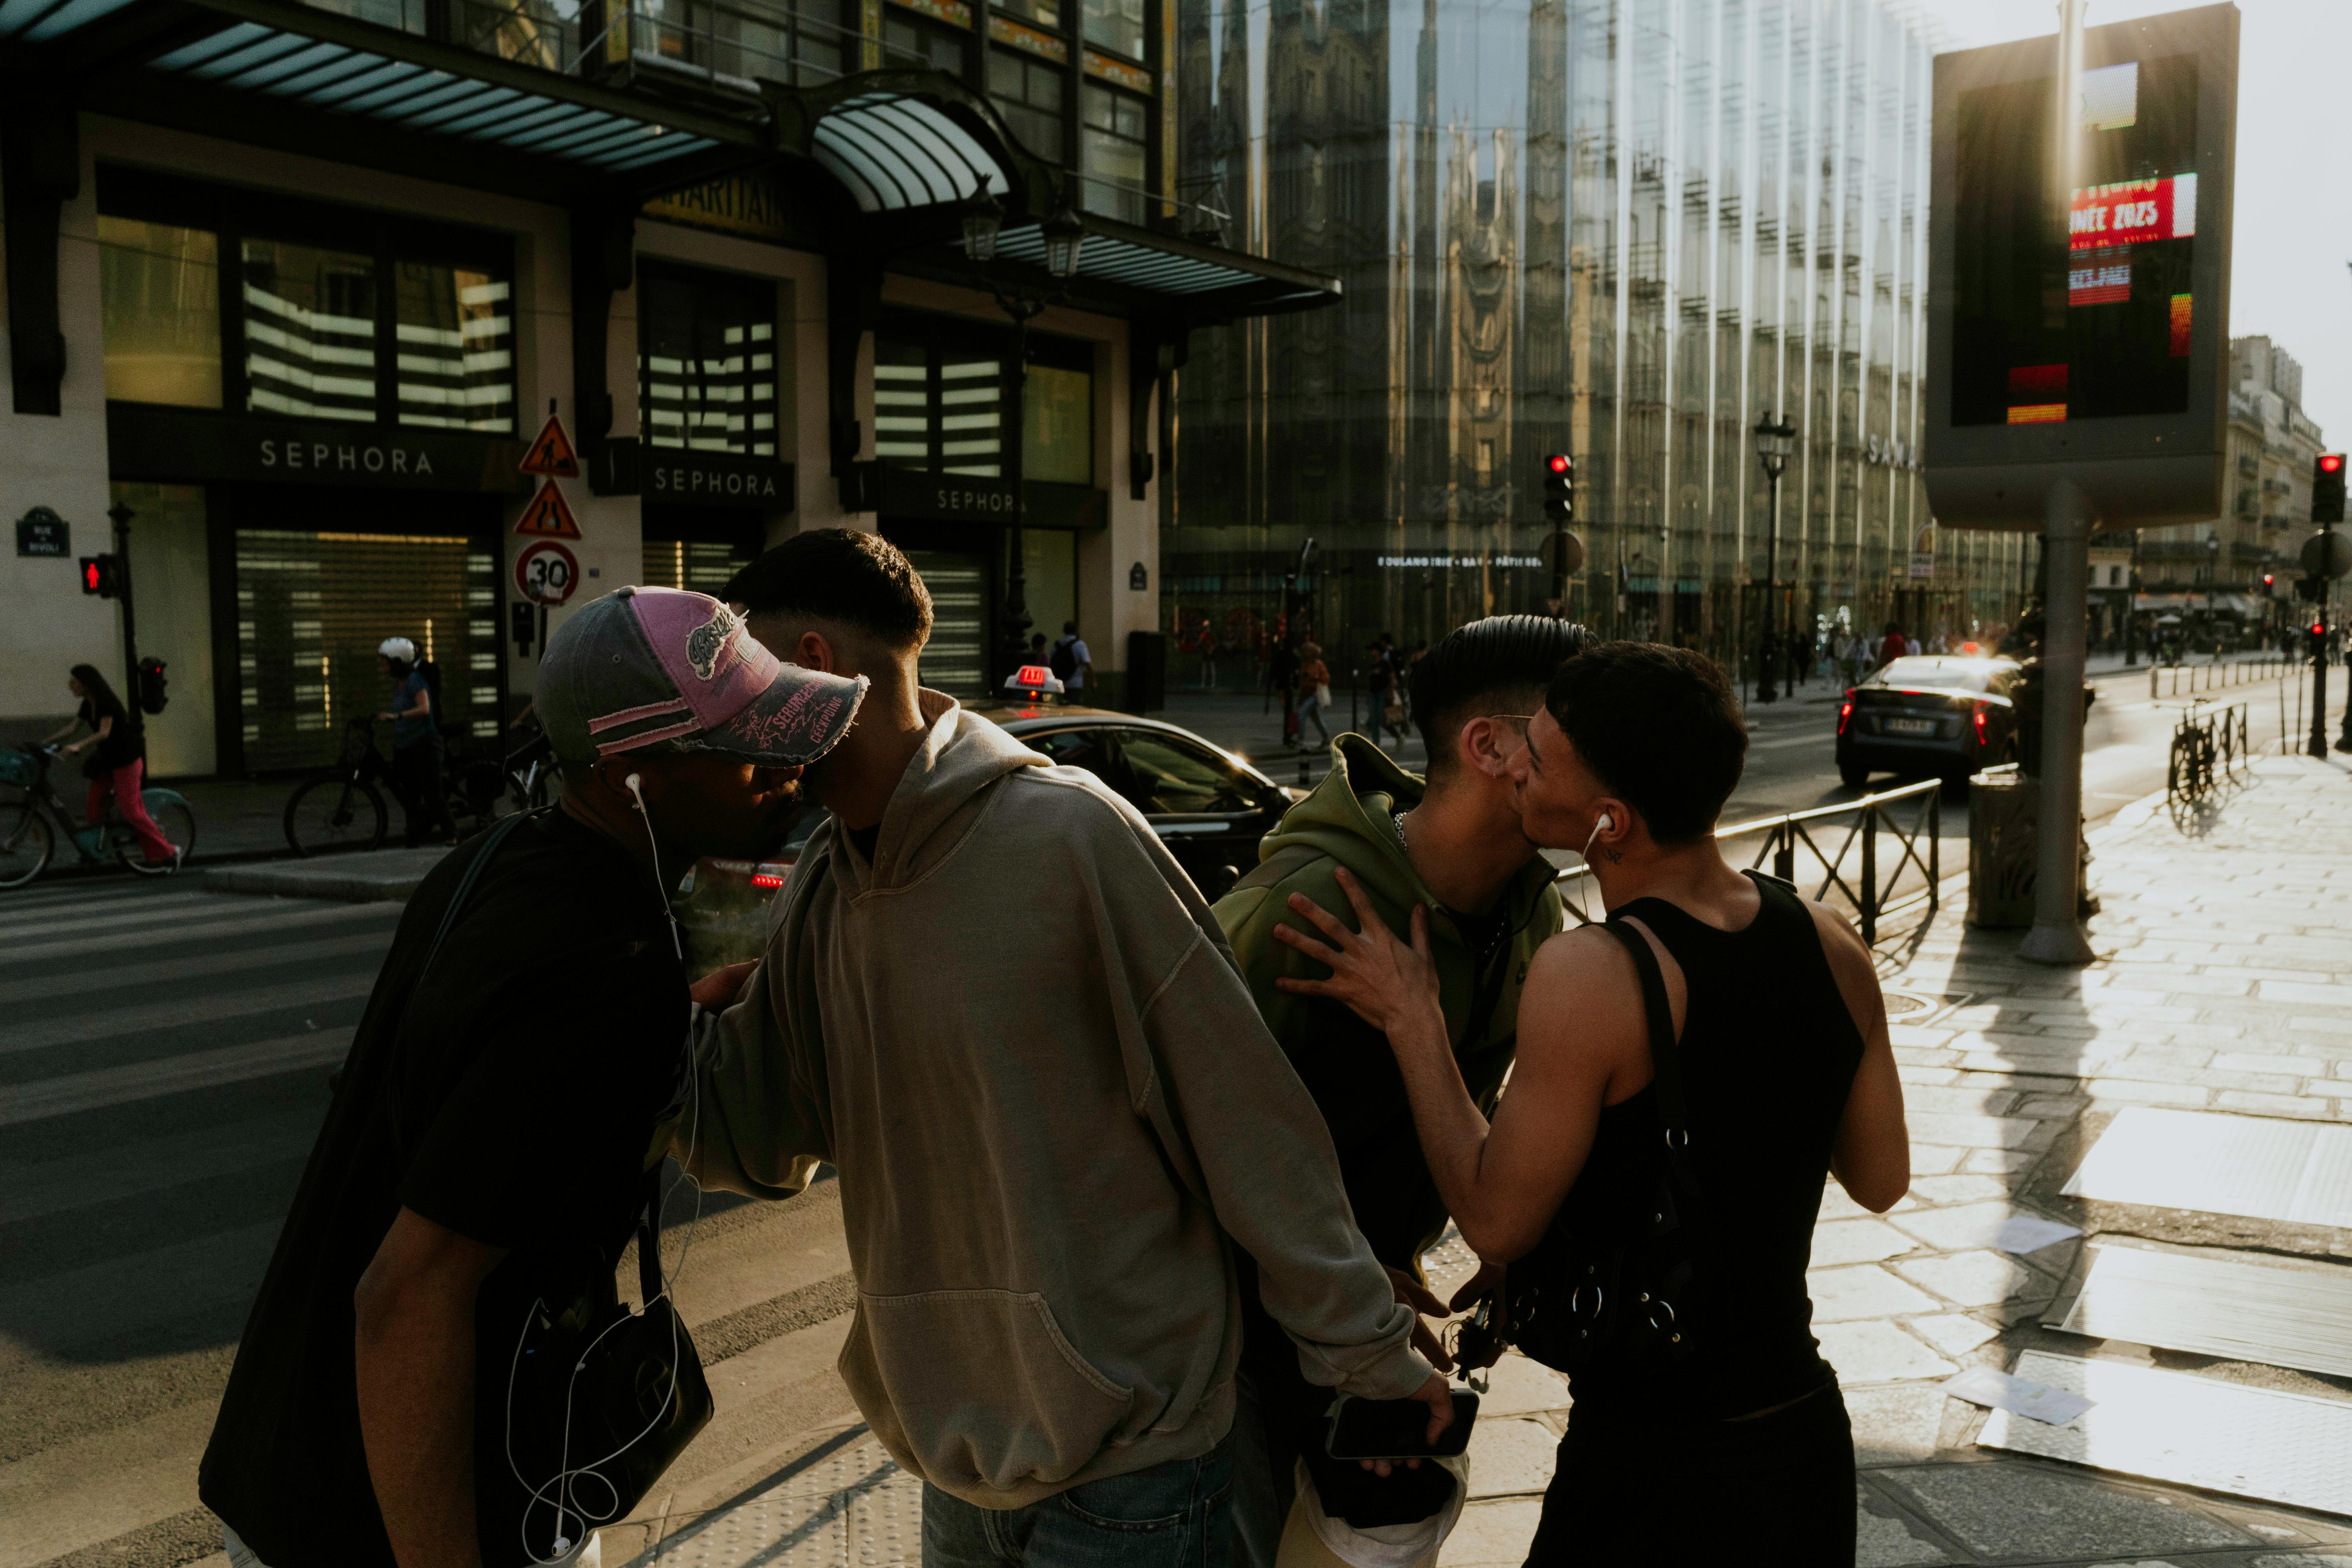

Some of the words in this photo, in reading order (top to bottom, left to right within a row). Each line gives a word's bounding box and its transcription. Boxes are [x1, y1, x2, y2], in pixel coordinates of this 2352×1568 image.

[261, 439, 433, 475] SEPHORA
[655, 467, 776, 497] SEPHORA
[530, 559, 569, 588] 30
